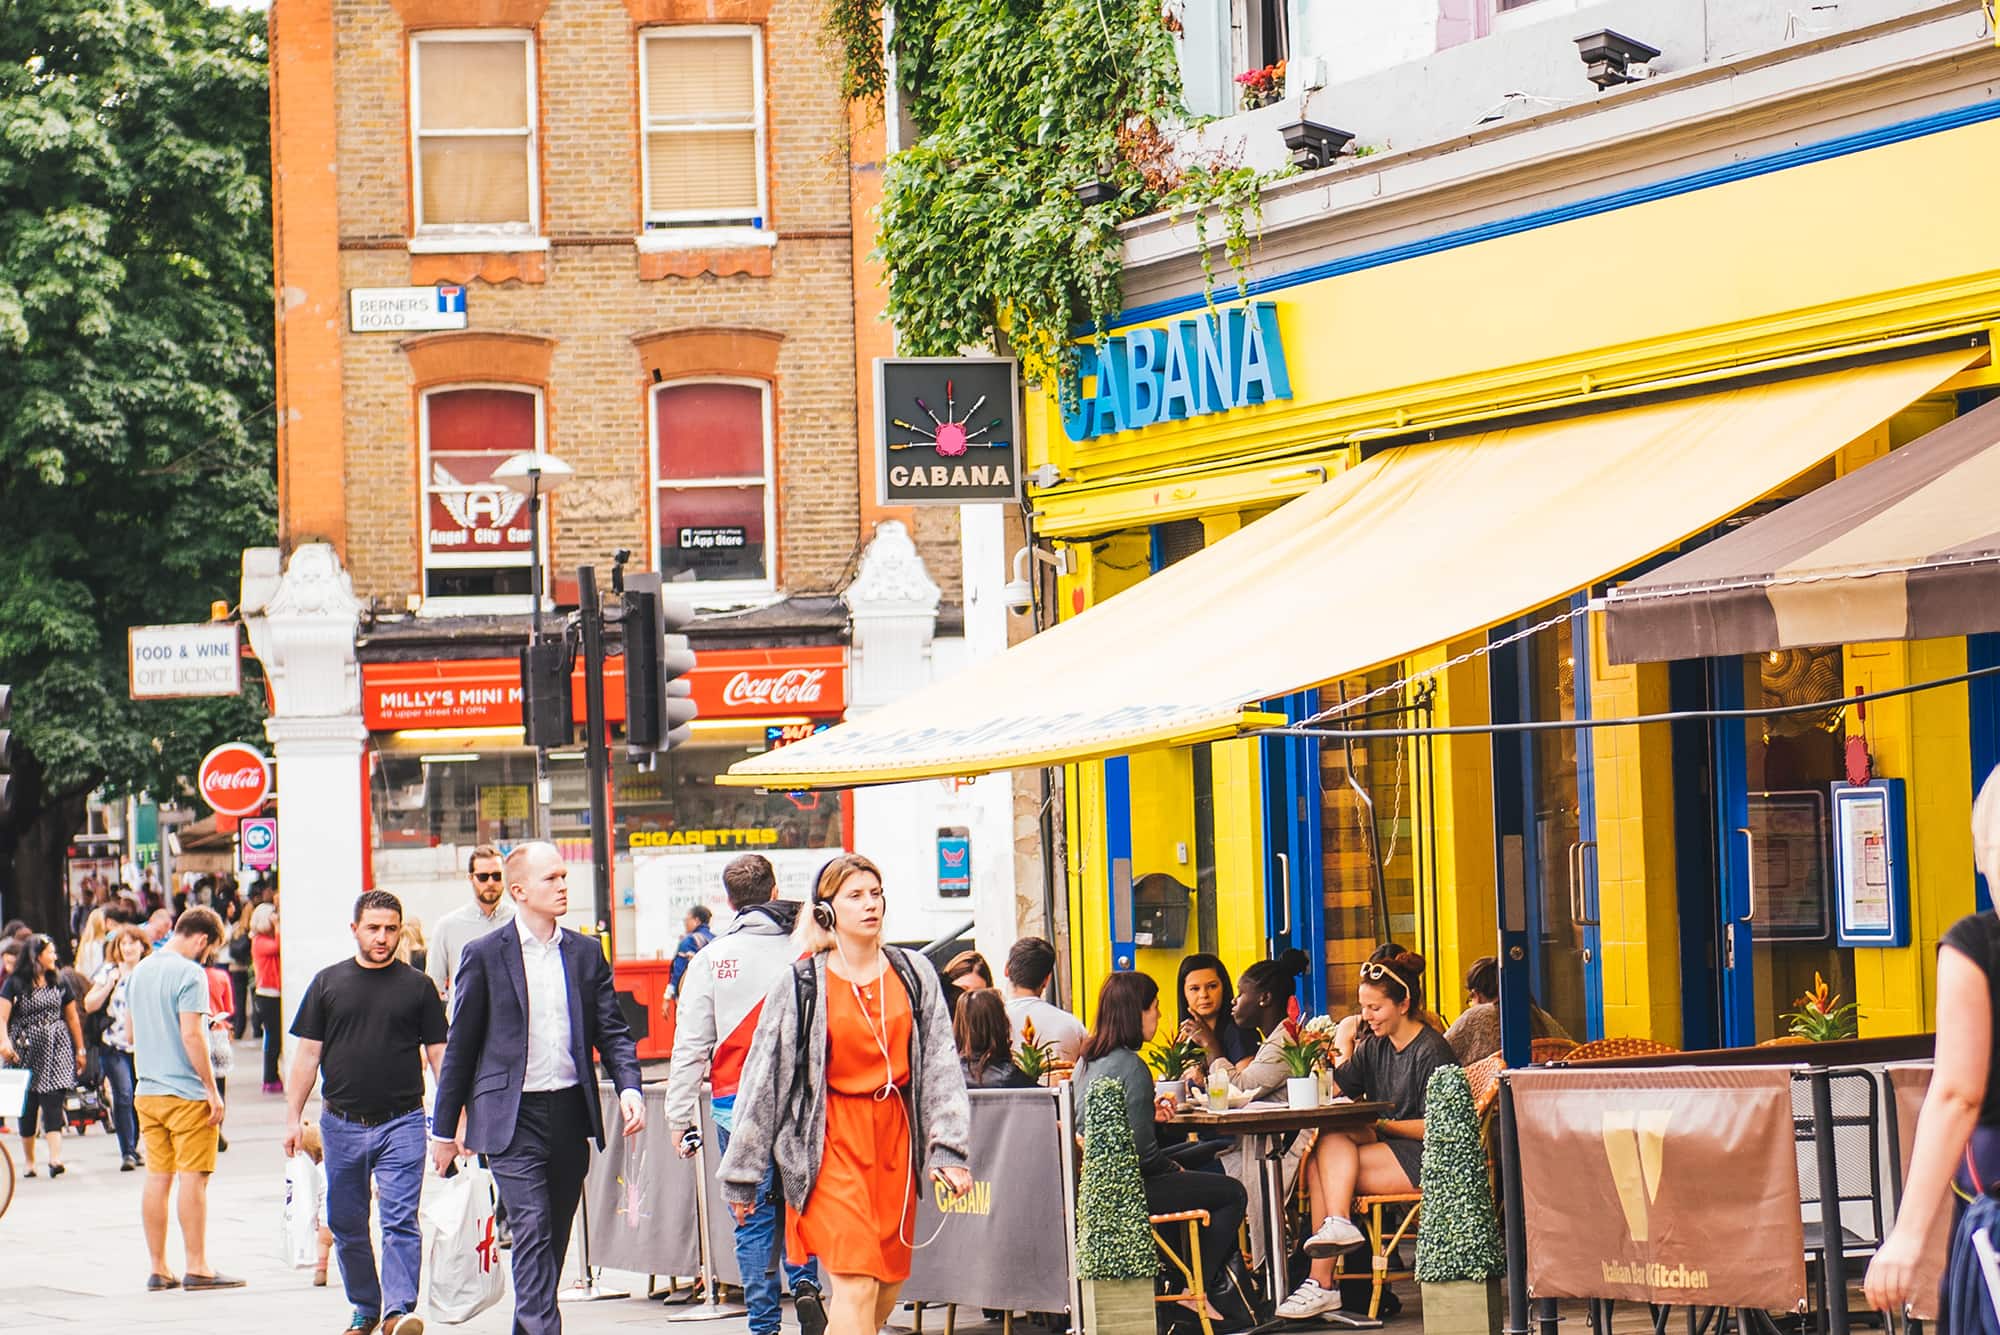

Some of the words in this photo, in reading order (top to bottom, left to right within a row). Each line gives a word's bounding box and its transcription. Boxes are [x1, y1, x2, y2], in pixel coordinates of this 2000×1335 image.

[360, 298, 429, 312] BERNERS
[360, 313, 405, 327] ROAD
[889, 465, 1011, 487] CABANA
[430, 529, 467, 546] Angel
[474, 528, 500, 545] City
[507, 527, 532, 544] Car
[692, 535, 714, 548] App
[715, 534, 744, 547] Store
[136, 645, 172, 660] FOOD
[179, 644, 188, 657] &
[196, 642, 230, 657] WINE
[723, 669, 827, 706] Coca-Cola
[380, 690, 454, 708] MILLY'S
[460, 688, 502, 705] MINI
[629, 828, 778, 847] CIGARETTES
[711, 959, 738, 971] JUST
[718, 969, 740, 979] EAT
[1645, 1262, 1709, 1289] Kitchen
